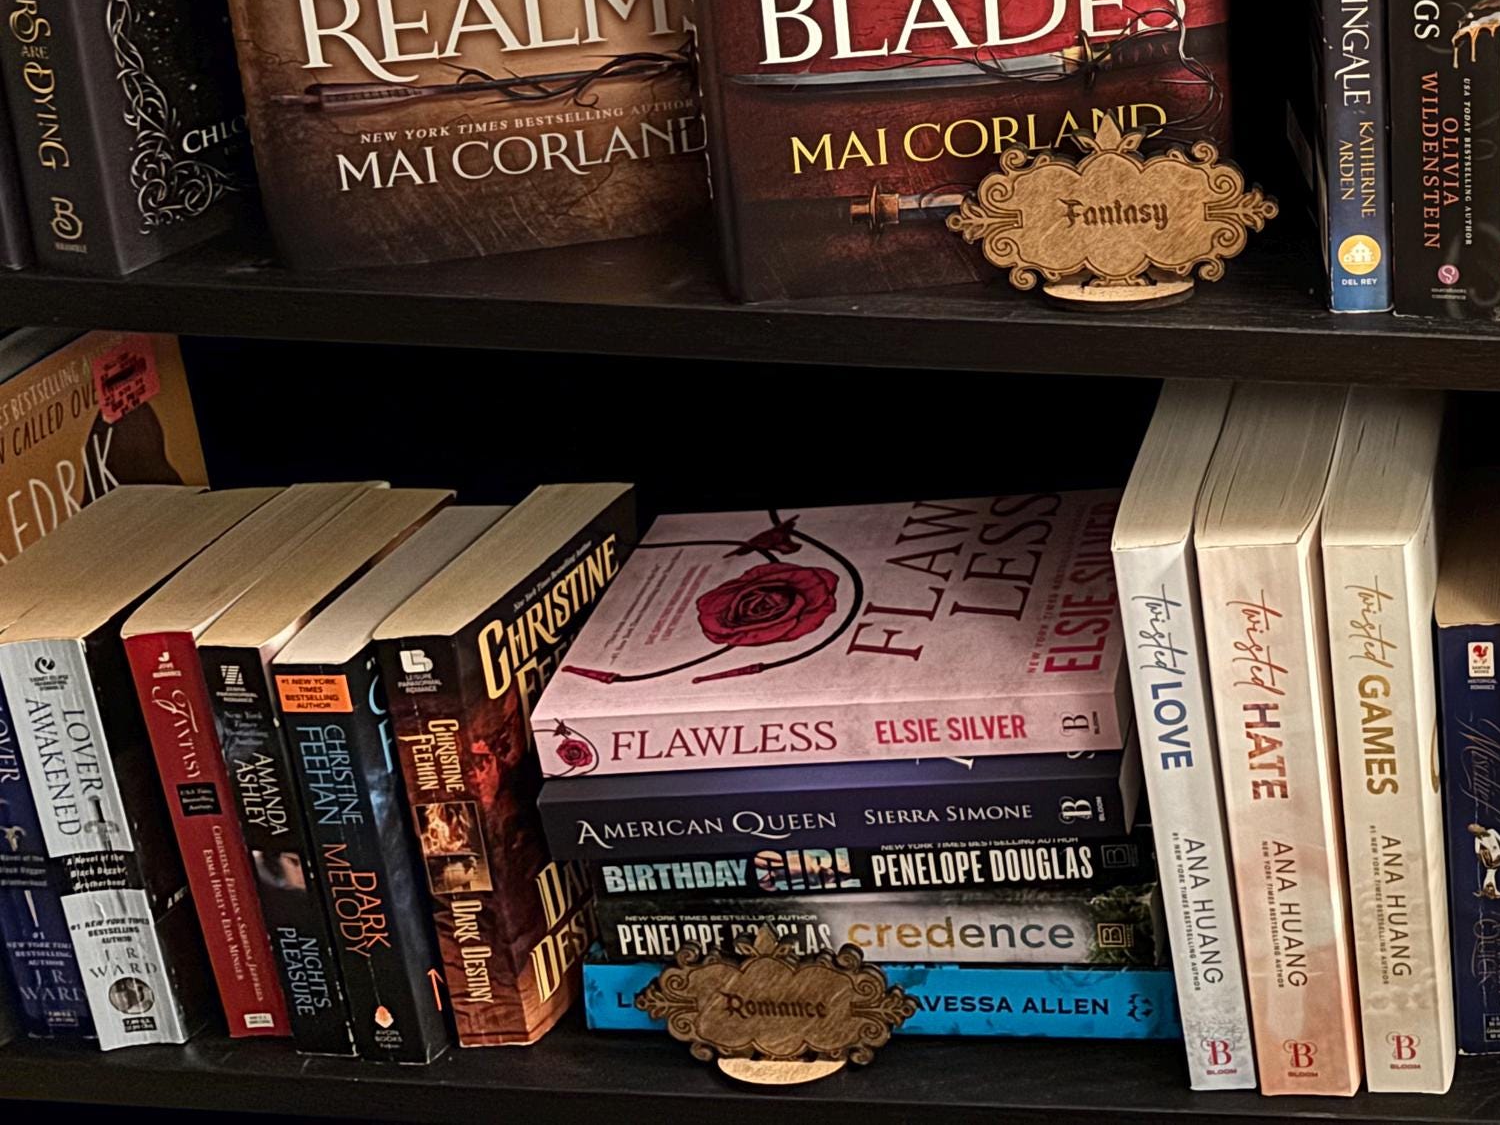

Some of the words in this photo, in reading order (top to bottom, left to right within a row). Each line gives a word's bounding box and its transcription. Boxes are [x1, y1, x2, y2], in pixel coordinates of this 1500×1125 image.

[335, 146, 438, 192] MAI
[452, 115, 708, 180] CORLAND
[790, 129, 888, 174] MAI
[1338, 139, 1355, 201] ARDEN
[1358, 121, 1376, 218] KATHERINE
[1420, 71, 1441, 250] WILDENSTEIN
[1441, 117, 1461, 207] OLIVIA
[1058, 196, 1169, 230] Fantasy
[1131, 583, 1189, 676] twisted
[25, 698, 82, 836] AWAKENED
[62, 708, 104, 795] LOVER
[611, 721, 838, 761] FLAWLESS
[875, 718, 942, 745] ELSIE
[947, 714, 1028, 741] SILVER
[1150, 681, 1194, 770] LOVE
[233, 759, 268, 827] ASHLEY
[252, 752, 289, 835] AMANDA
[296, 726, 342, 824] FEEHAN
[323, 725, 364, 825] CHRISTINE
[577, 817, 724, 850] AMERICAN
[732, 811, 837, 840] QUEEN
[864, 809, 940, 825] SIERRA
[946, 804, 1033, 822] SIMONE
[1183, 837, 1211, 890] ANA
[1272, 840, 1297, 892] ANA
[1381, 835, 1404, 884] ANA
[602, 859, 748, 894] BIRTHDAY
[754, 847, 863, 893] GIRL
[871, 850, 985, 888] PENELOPE
[989, 845, 1095, 883] DOUGLAS
[277, 927, 316, 1016] PLEASURE
[847, 916, 1075, 949] credence
[1193, 900, 1224, 984] HUANG
[1279, 902, 1308, 988] HUANG
[1386, 894, 1412, 977] HUANG
[720, 991, 827, 1021] Romance
